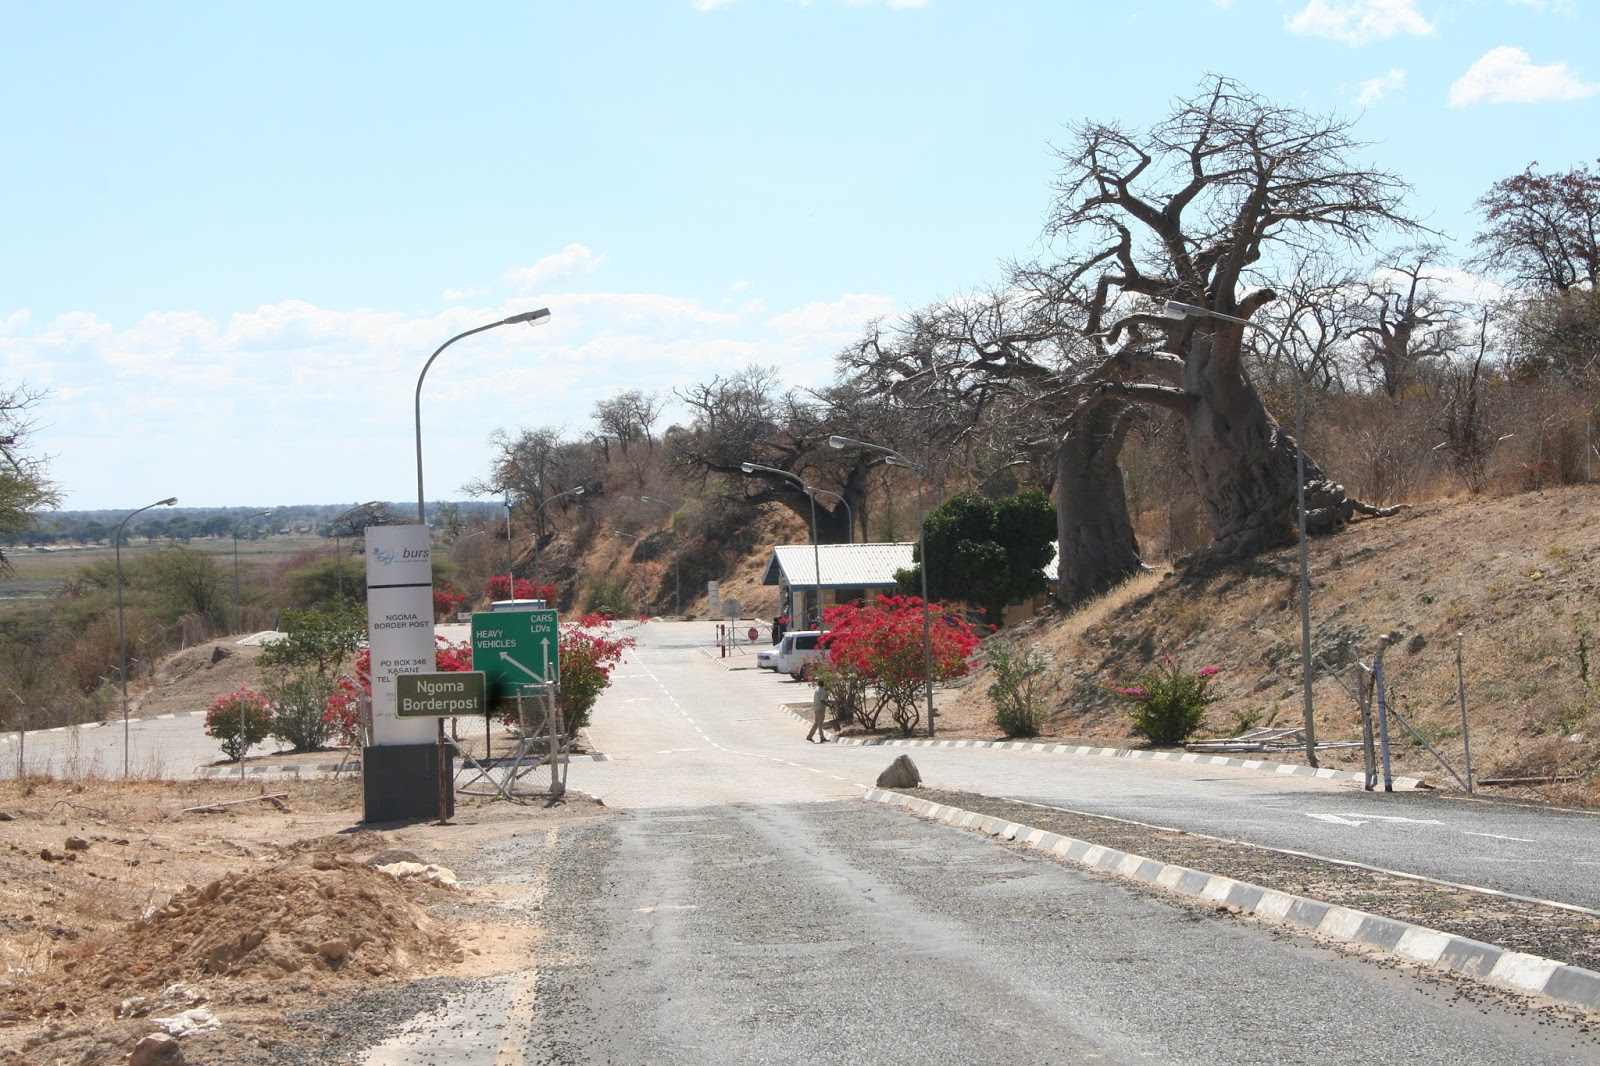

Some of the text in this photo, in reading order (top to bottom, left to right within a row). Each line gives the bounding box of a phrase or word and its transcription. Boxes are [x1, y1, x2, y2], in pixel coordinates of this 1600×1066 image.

[402, 547, 429, 558] burs
[385, 613, 418, 621] NGOMA
[530, 614, 553, 623] CARS
[409, 620, 430, 628] POST
[530, 624, 551, 633] LDVs
[476, 629, 503, 638] HEAVY
[477, 639, 517, 648] VEHICLES
[393, 659, 411, 667] BOX
[387, 666, 420, 674] KASANE
[416, 680, 464, 696] Ngoma
[403, 696, 479, 713] Borderpost
